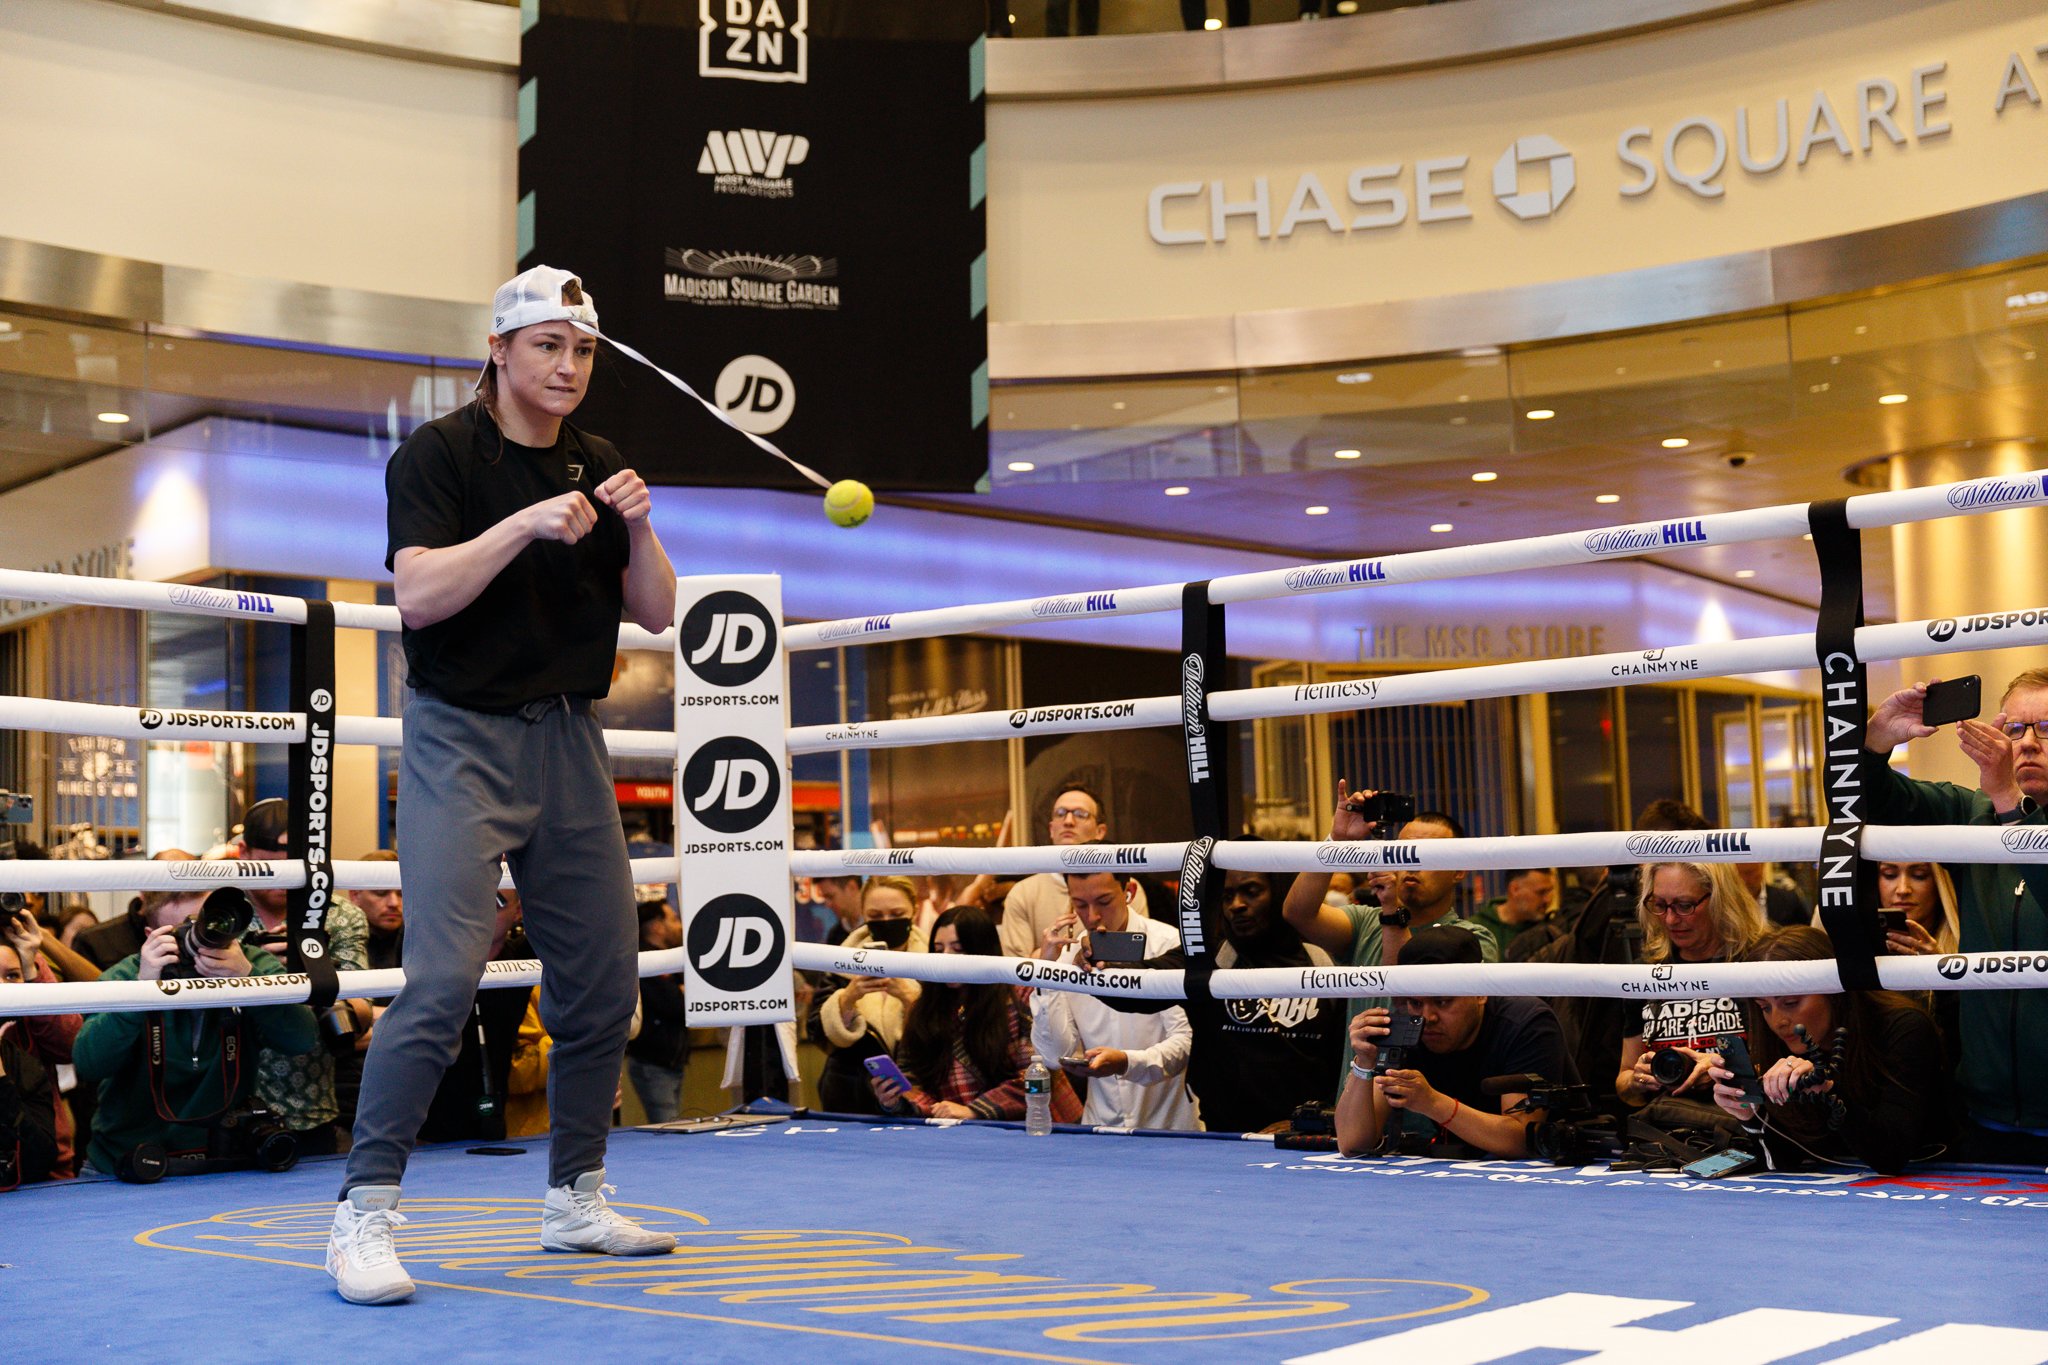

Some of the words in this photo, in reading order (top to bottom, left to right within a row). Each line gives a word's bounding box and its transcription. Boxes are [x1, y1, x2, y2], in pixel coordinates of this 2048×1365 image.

[726, 30, 783, 65] ZN
[1148, 155, 1472, 245] CHASE
[1617, 61, 1952, 199] SQUARE
[1995, 47, 2048, 114] A
[664, 273, 728, 299] MADISON
[731, 276, 783, 303] SQUARE
[787, 280, 840, 306] GARDEN
[1947, 470, 2041, 511] William
[1585, 527, 1662, 555] William
[1662, 521, 1707, 544] HILL
[1285, 565, 1348, 591] William
[1348, 561, 1386, 583] HILL
[168, 585, 236, 609] William
[236, 593, 274, 613] HILL
[1032, 597, 1086, 617] William
[1086, 593, 1117, 613] HILL
[865, 615, 891, 632] HILL
[1355, 625, 1411, 660] THE
[1425, 624, 1492, 658] MSG
[1507, 623, 1606, 658] STORE
[1611, 658, 1699, 677] CHAINMYNE
[680, 694, 780, 707] JDSPORTS.COM
[1294, 680, 1382, 701] Hennessy
[167, 711, 296, 731] JDSPORTS.COM
[1030, 703, 1135, 724] JDSPORTS.COM
[825, 729, 878, 741] CHAINMYNE
[1189, 736, 1210, 784] HILL
[1822, 652, 1861, 907] CHAINMYNE
[302, 722, 330, 930] JDSPORTS.COM
[684, 840, 784, 855] JDSPORTS.COM
[1317, 844, 1382, 866] William
[1382, 845, 1420, 865] HILL
[1626, 832, 1704, 857] William
[1705, 831, 1751, 853] HILL
[888, 850, 914, 865] HILL
[1060, 848, 1116, 867] William
[1116, 847, 1148, 865] HILL
[168, 861, 236, 880] William
[237, 862, 275, 878] HILL
[1180, 910, 1206, 957] HILL
[834, 961, 886, 976] CHAINMYNE
[1036, 966, 1142, 990] JDSPORTS.COM
[1301, 969, 1389, 991] Hennessy
[1621, 980, 1710, 993] CHAINMYNE
[688, 998, 788, 1013] JDSPORTS.COM
[152, 1025, 161, 1065] Canon
[226, 1035, 237, 1061] EOS
